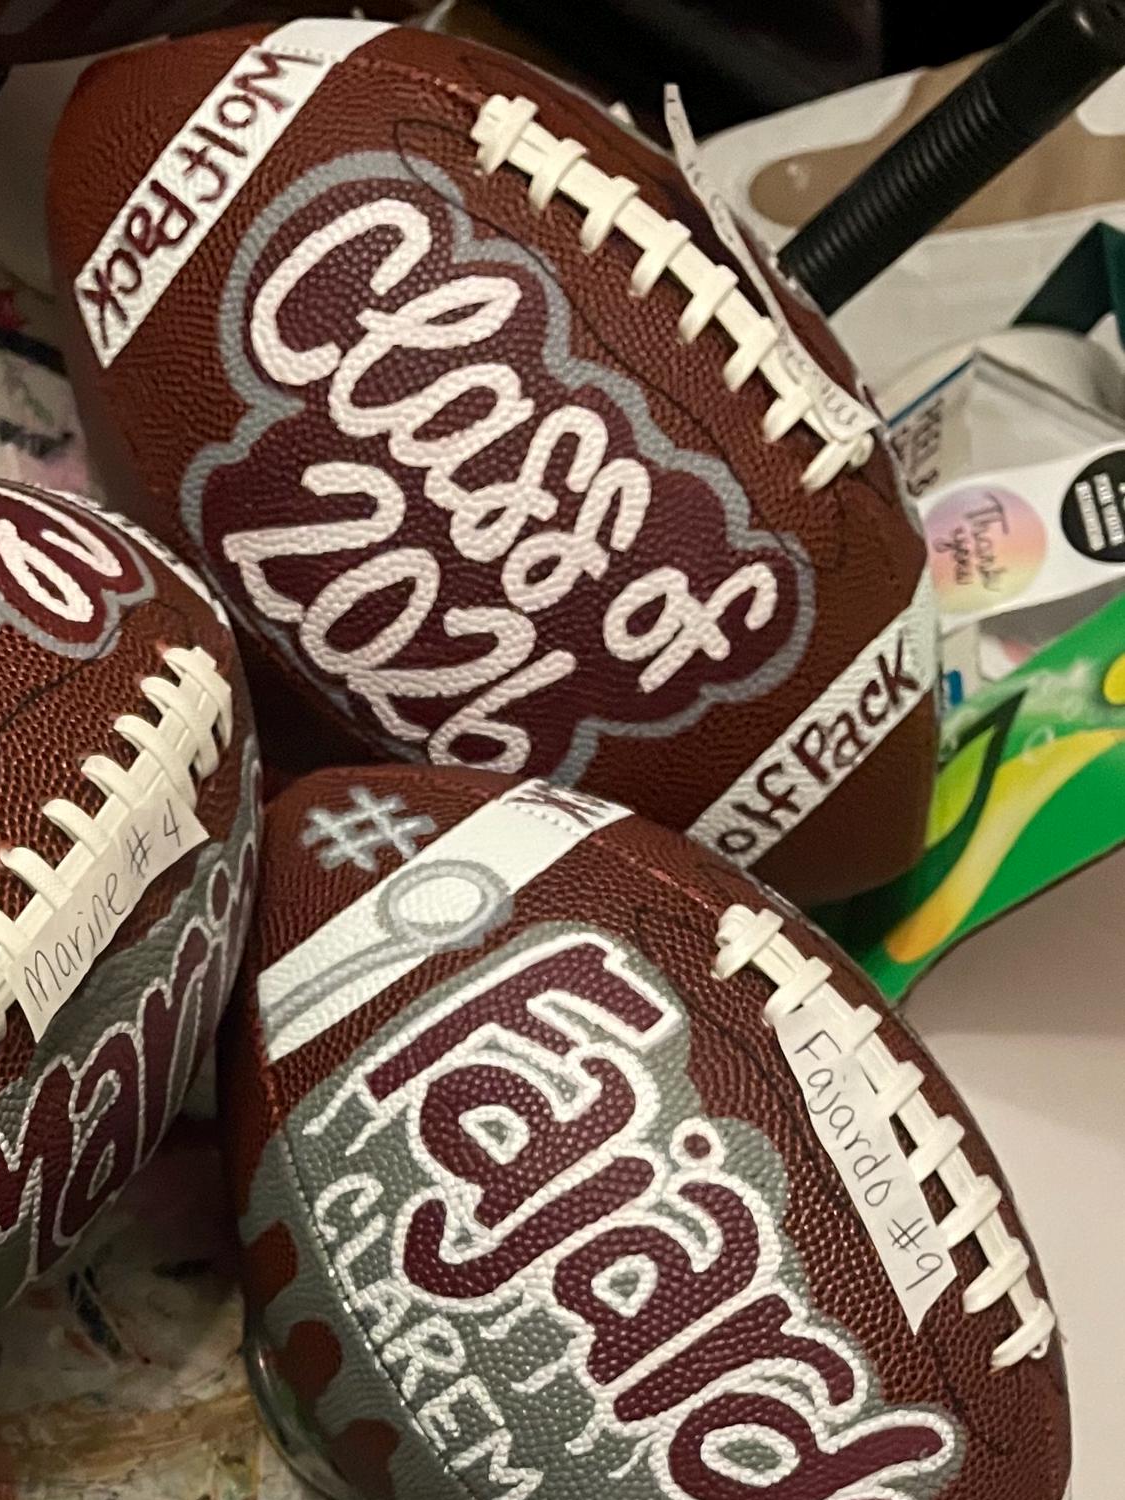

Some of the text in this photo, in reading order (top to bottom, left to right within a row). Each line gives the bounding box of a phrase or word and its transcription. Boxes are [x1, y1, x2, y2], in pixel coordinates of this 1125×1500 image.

[81, 51, 322, 349] Wolf Pack
[250, 198, 778, 693] Class of
[932, 526, 973, 586] you
[965, 490, 1009, 593] Thank
[223, 461, 576, 774] 2026
[716, 630, 920, 853] olf Pack
[24, 873, 127, 1012] Marine
[794, 1030, 944, 1292] Fajardo #9
